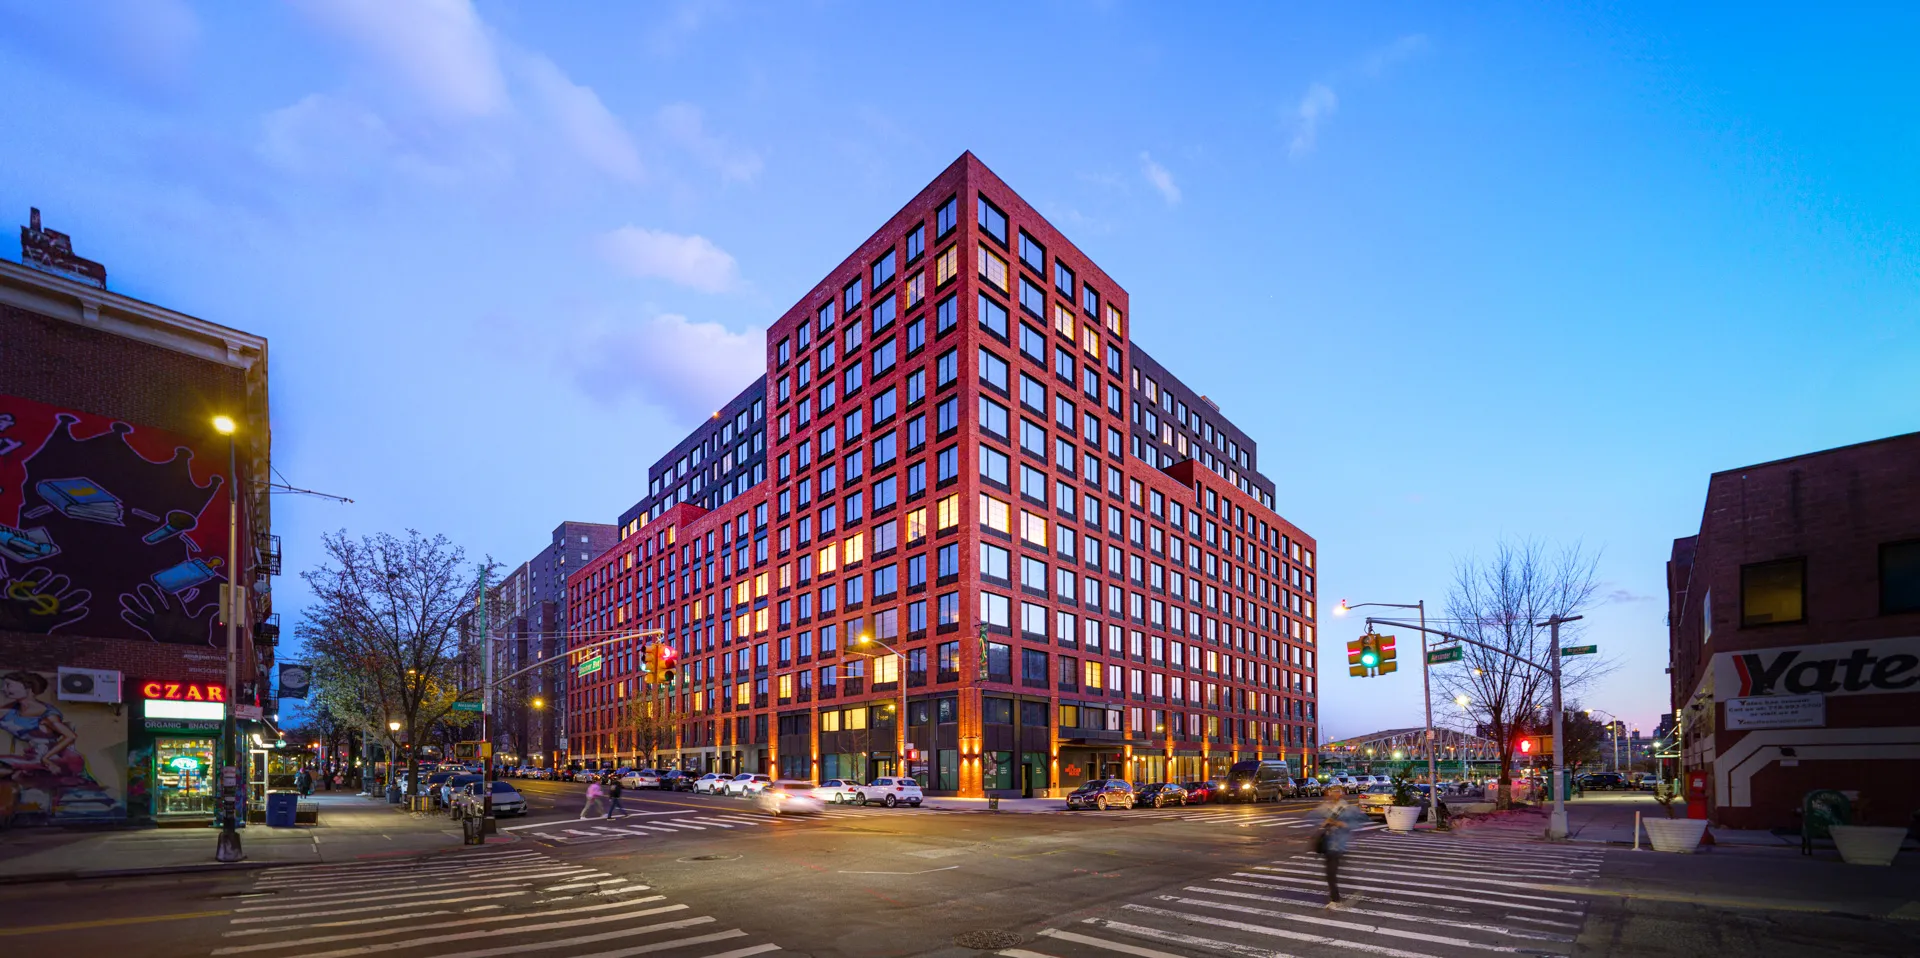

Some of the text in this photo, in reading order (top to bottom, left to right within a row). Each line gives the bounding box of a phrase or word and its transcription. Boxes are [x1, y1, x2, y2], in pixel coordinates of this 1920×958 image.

[1742, 649, 1920, 696] Yate
[143, 682, 225, 701] CZAR
[144, 721, 182, 729] ORGANIC
